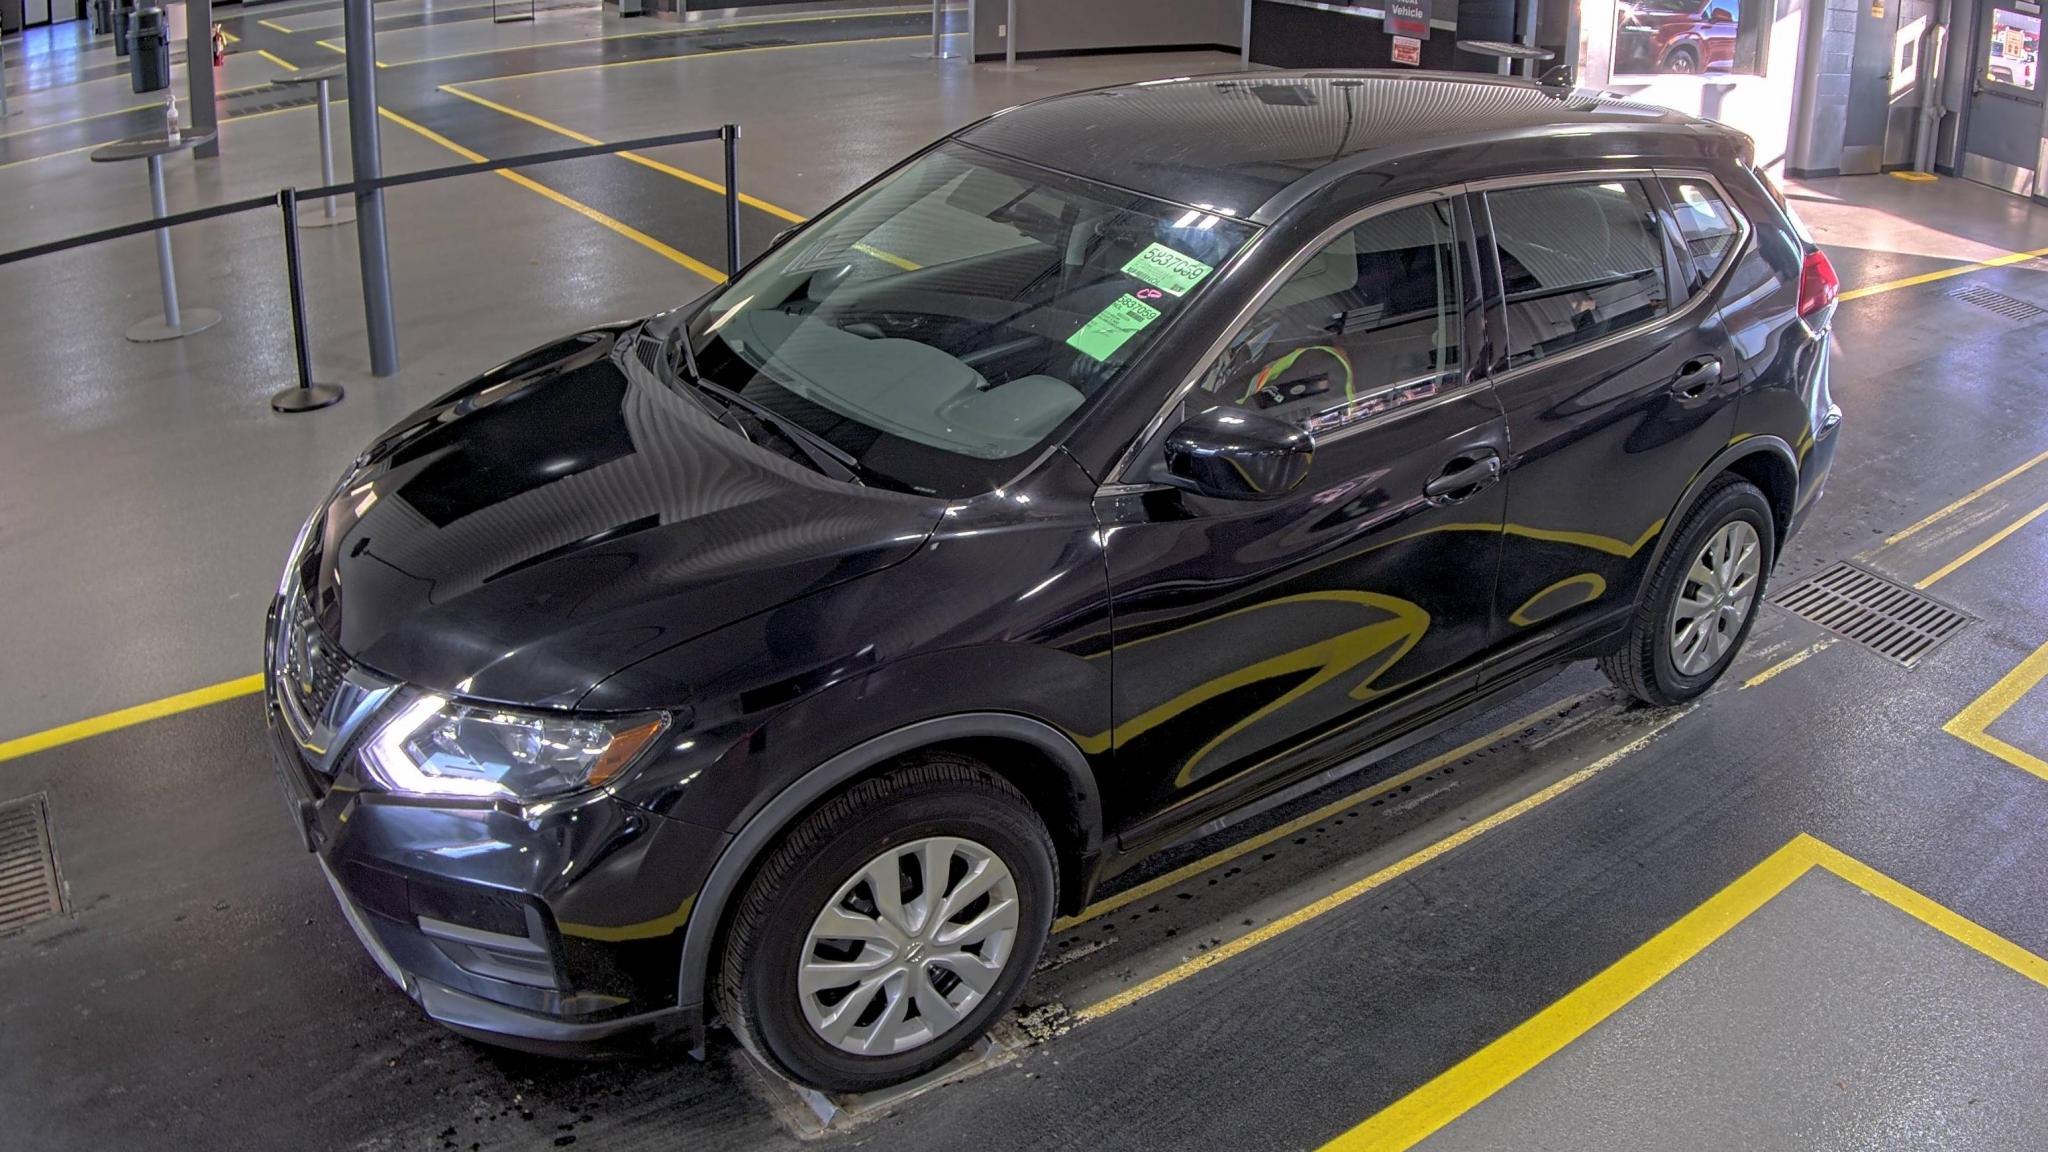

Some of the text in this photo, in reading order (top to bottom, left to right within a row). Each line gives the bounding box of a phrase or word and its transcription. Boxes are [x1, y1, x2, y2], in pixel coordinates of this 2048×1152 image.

[1392, 4, 1423, 18] Vehicle
[1144, 248, 1203, 280] 5837059
[1118, 296, 1156, 320] 5837059
